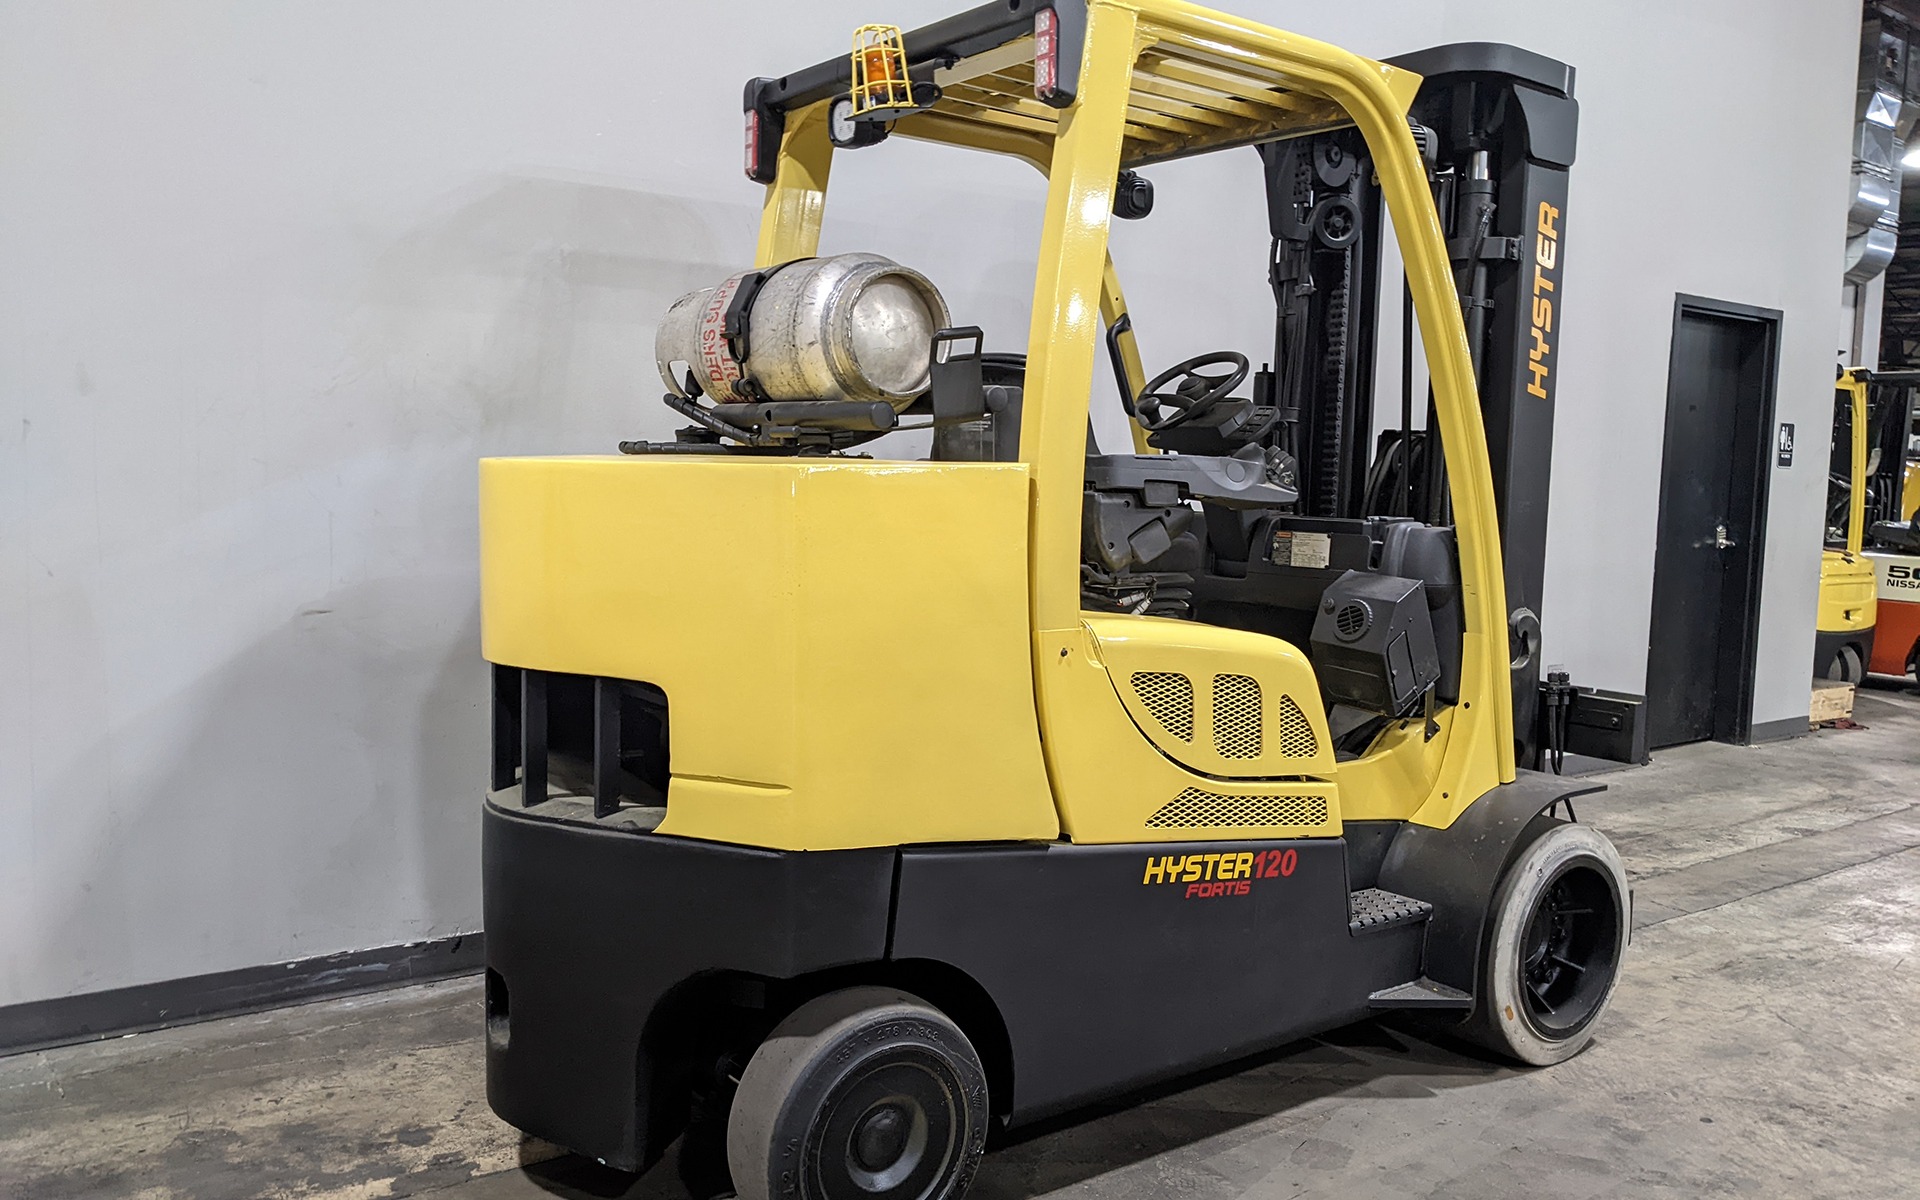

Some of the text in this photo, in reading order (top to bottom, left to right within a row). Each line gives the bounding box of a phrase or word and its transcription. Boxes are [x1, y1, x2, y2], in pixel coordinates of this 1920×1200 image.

[1527, 201, 1559, 399] HYSTER
[1143, 849, 1298, 885] HYSTER 120
[1185, 880, 1252, 898] FORTIS
